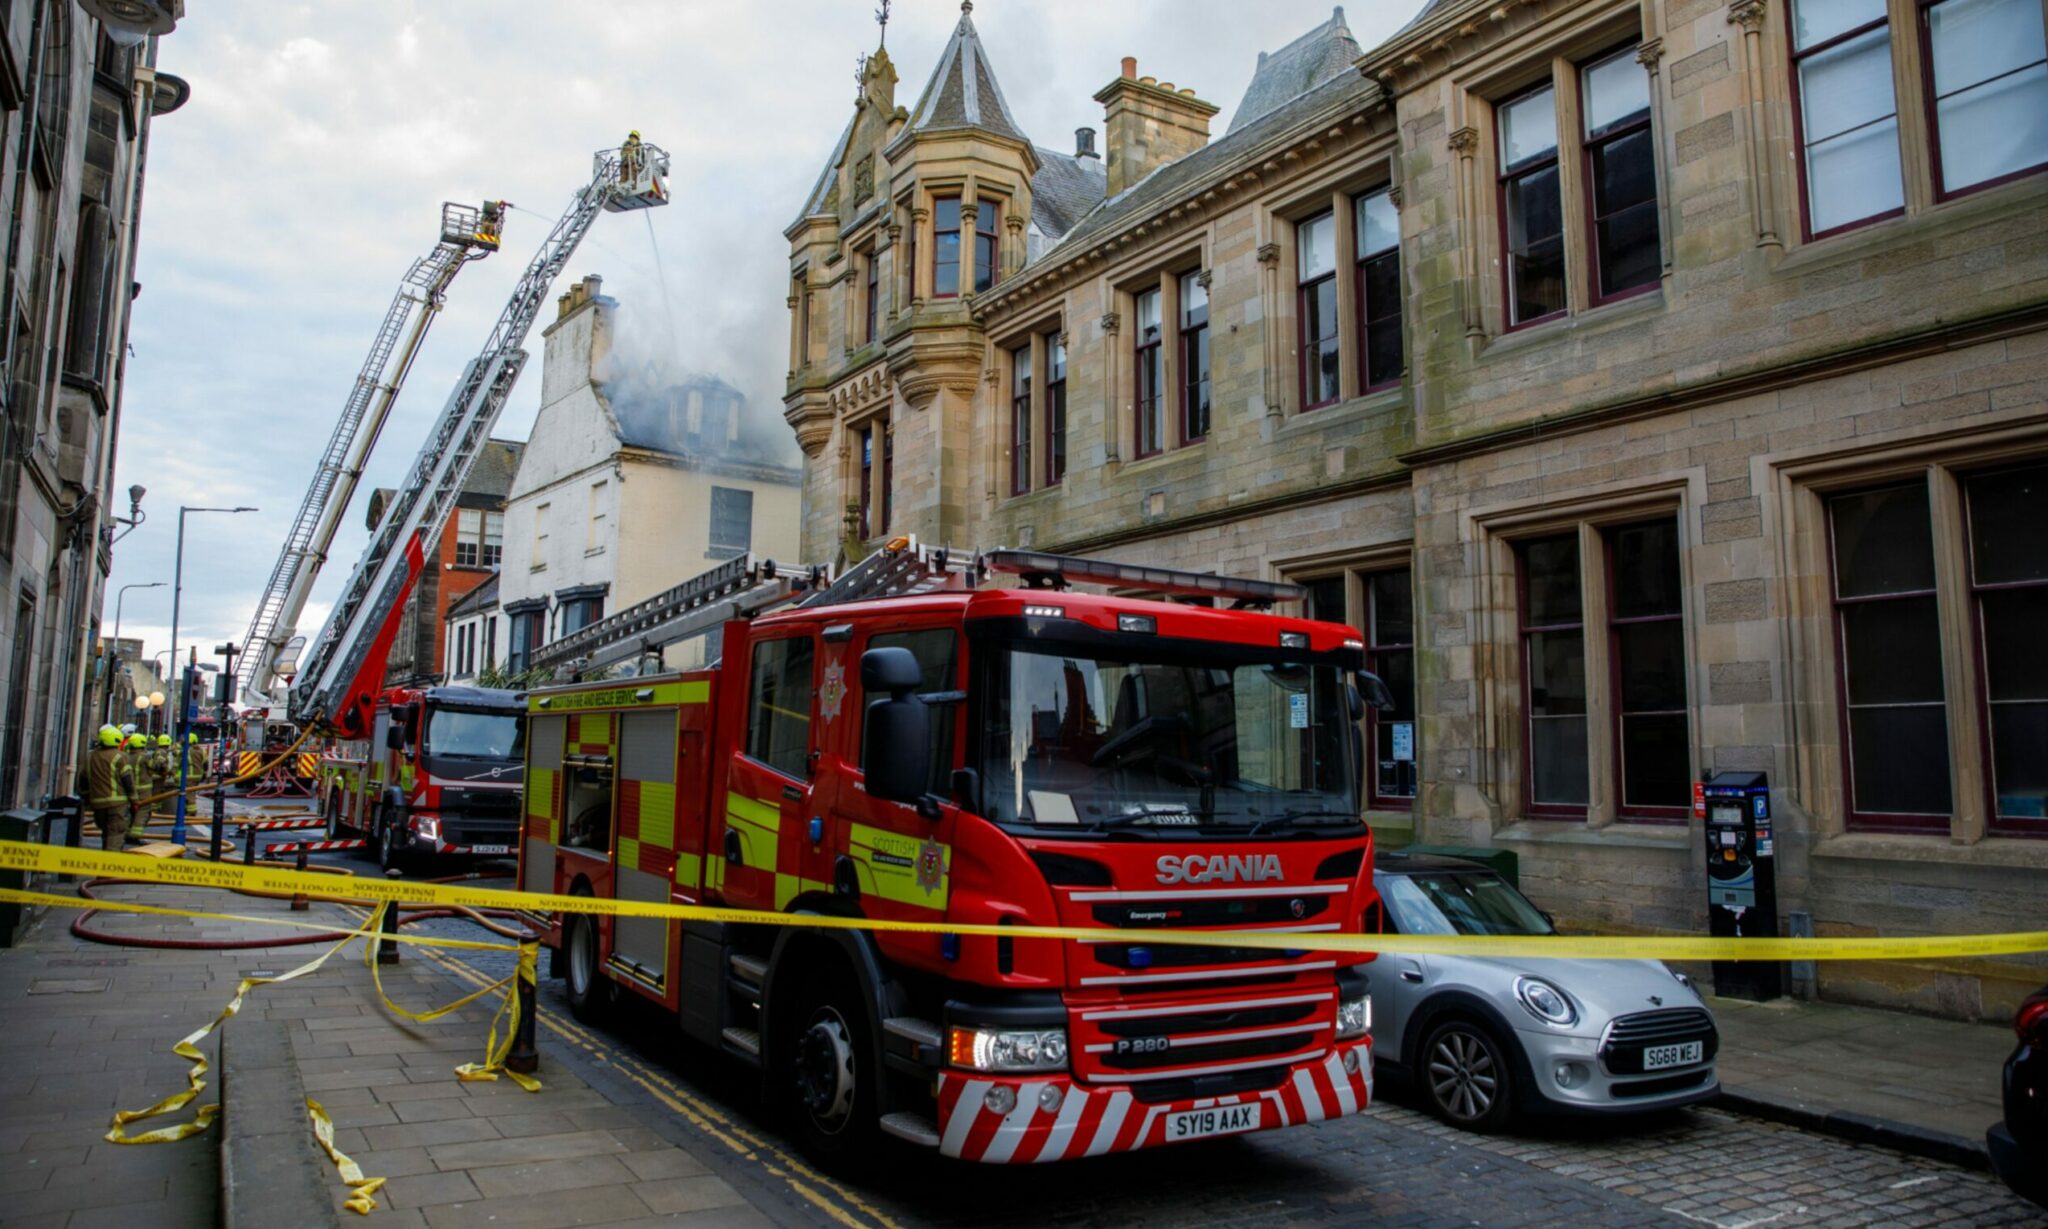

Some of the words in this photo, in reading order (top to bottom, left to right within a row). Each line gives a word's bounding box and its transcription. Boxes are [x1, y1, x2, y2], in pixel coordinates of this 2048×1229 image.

[424, 526, 441, 557] SCOTTISH
[2, 846, 41, 858] INNER
[872, 836, 915, 857] SCOTTISH
[8, 856, 40, 868] FIRE
[60, 859, 99, 871] ENTER
[101, 862, 126, 873] NOT
[126, 866, 147, 876] DO
[156, 863, 208, 876] CORDON
[209, 867, 245, 879] INNER
[1155, 854, 1285, 885] SCANIA
[157, 872, 211, 884] SERVICE
[215, 878, 244, 888] FIRE
[262, 880, 300, 890] ENTER
[301, 883, 325, 892] NOT
[325, 885, 344, 894] DO
[352, 882, 402, 895] CORDON
[403, 886, 437, 897] INNER
[539, 899, 584, 910] CORDON
[586, 901, 618, 912] INNER
[1117, 1040, 1130, 1054] P
[1132, 1037, 1169, 1053] 280
[1648, 1047, 1678, 1066] SG68
[1680, 1043, 1700, 1062] WEJ
[1176, 1111, 1215, 1136] SY19
[1219, 1106, 1252, 1130] AAX
